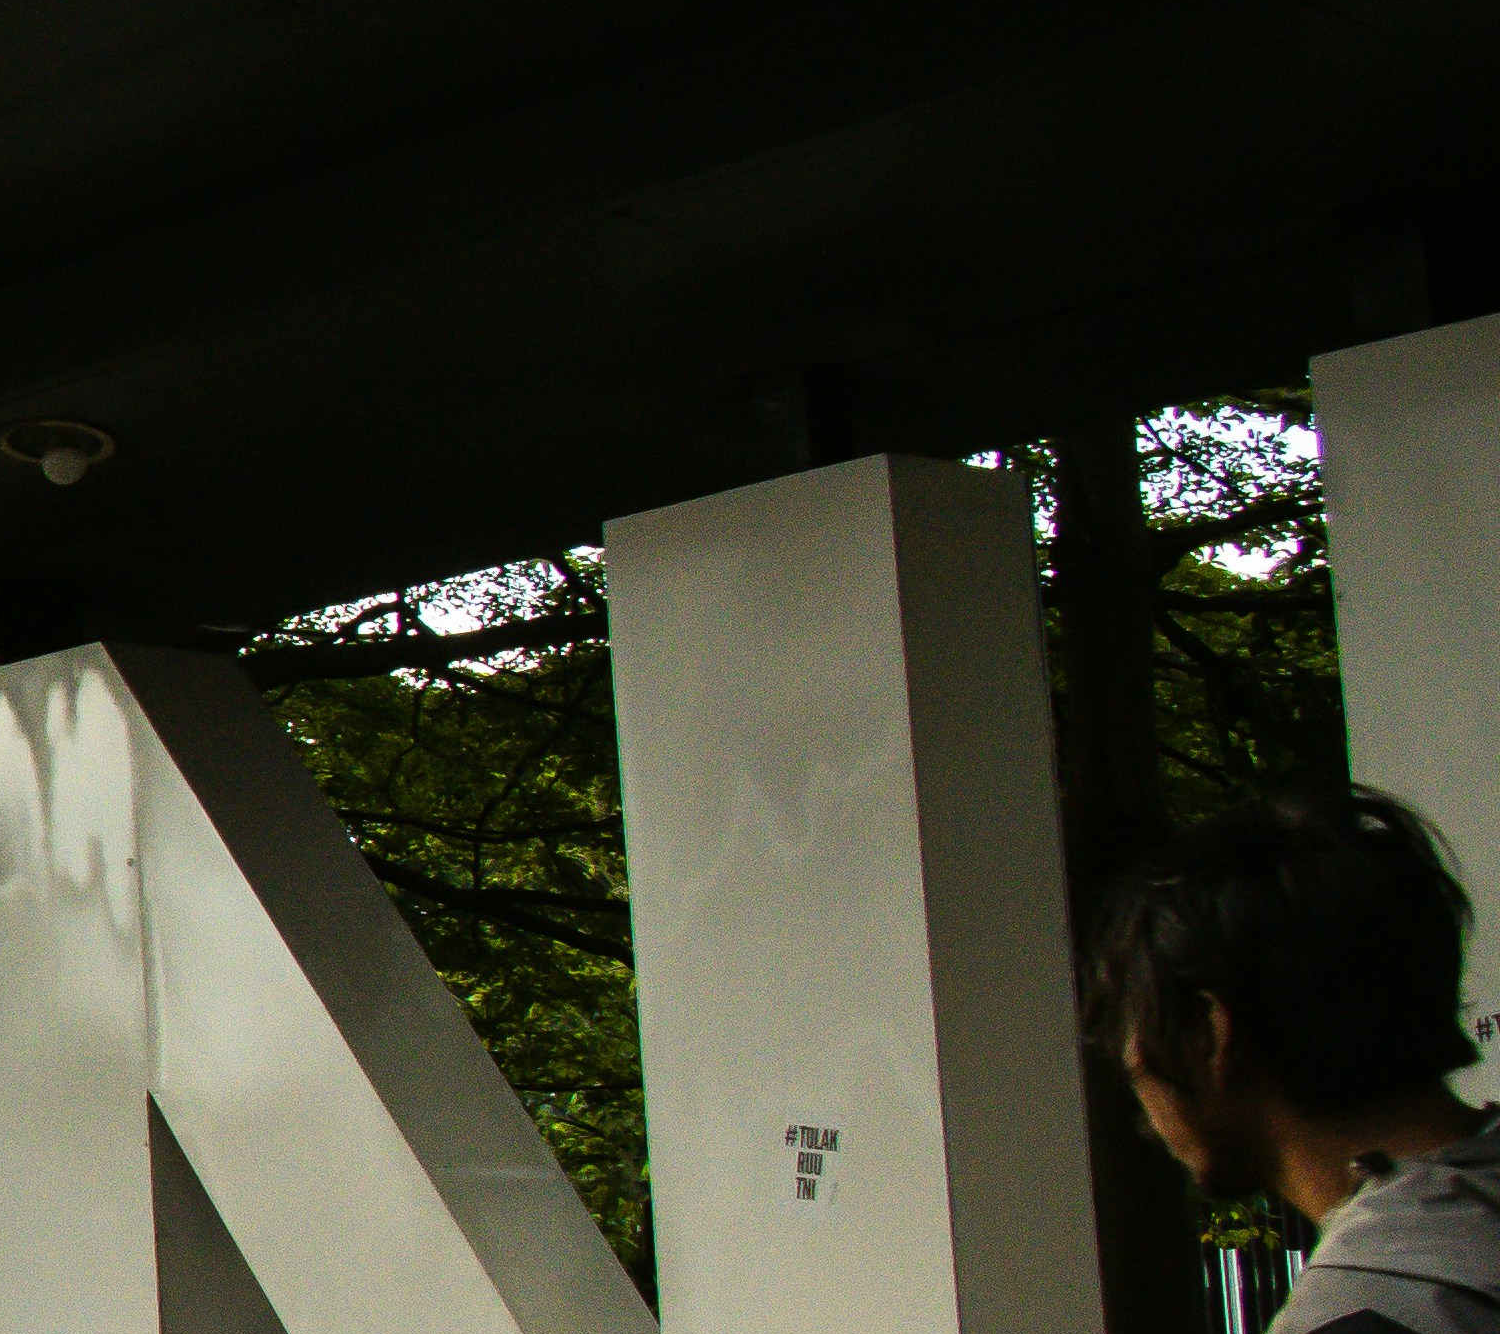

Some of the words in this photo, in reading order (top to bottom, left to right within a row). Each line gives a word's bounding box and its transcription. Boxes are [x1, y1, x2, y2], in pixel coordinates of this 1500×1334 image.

[784, 1124, 840, 1152] #TOLAK
[796, 1152, 824, 1176] RUU
[795, 1176, 818, 1201] TNI
